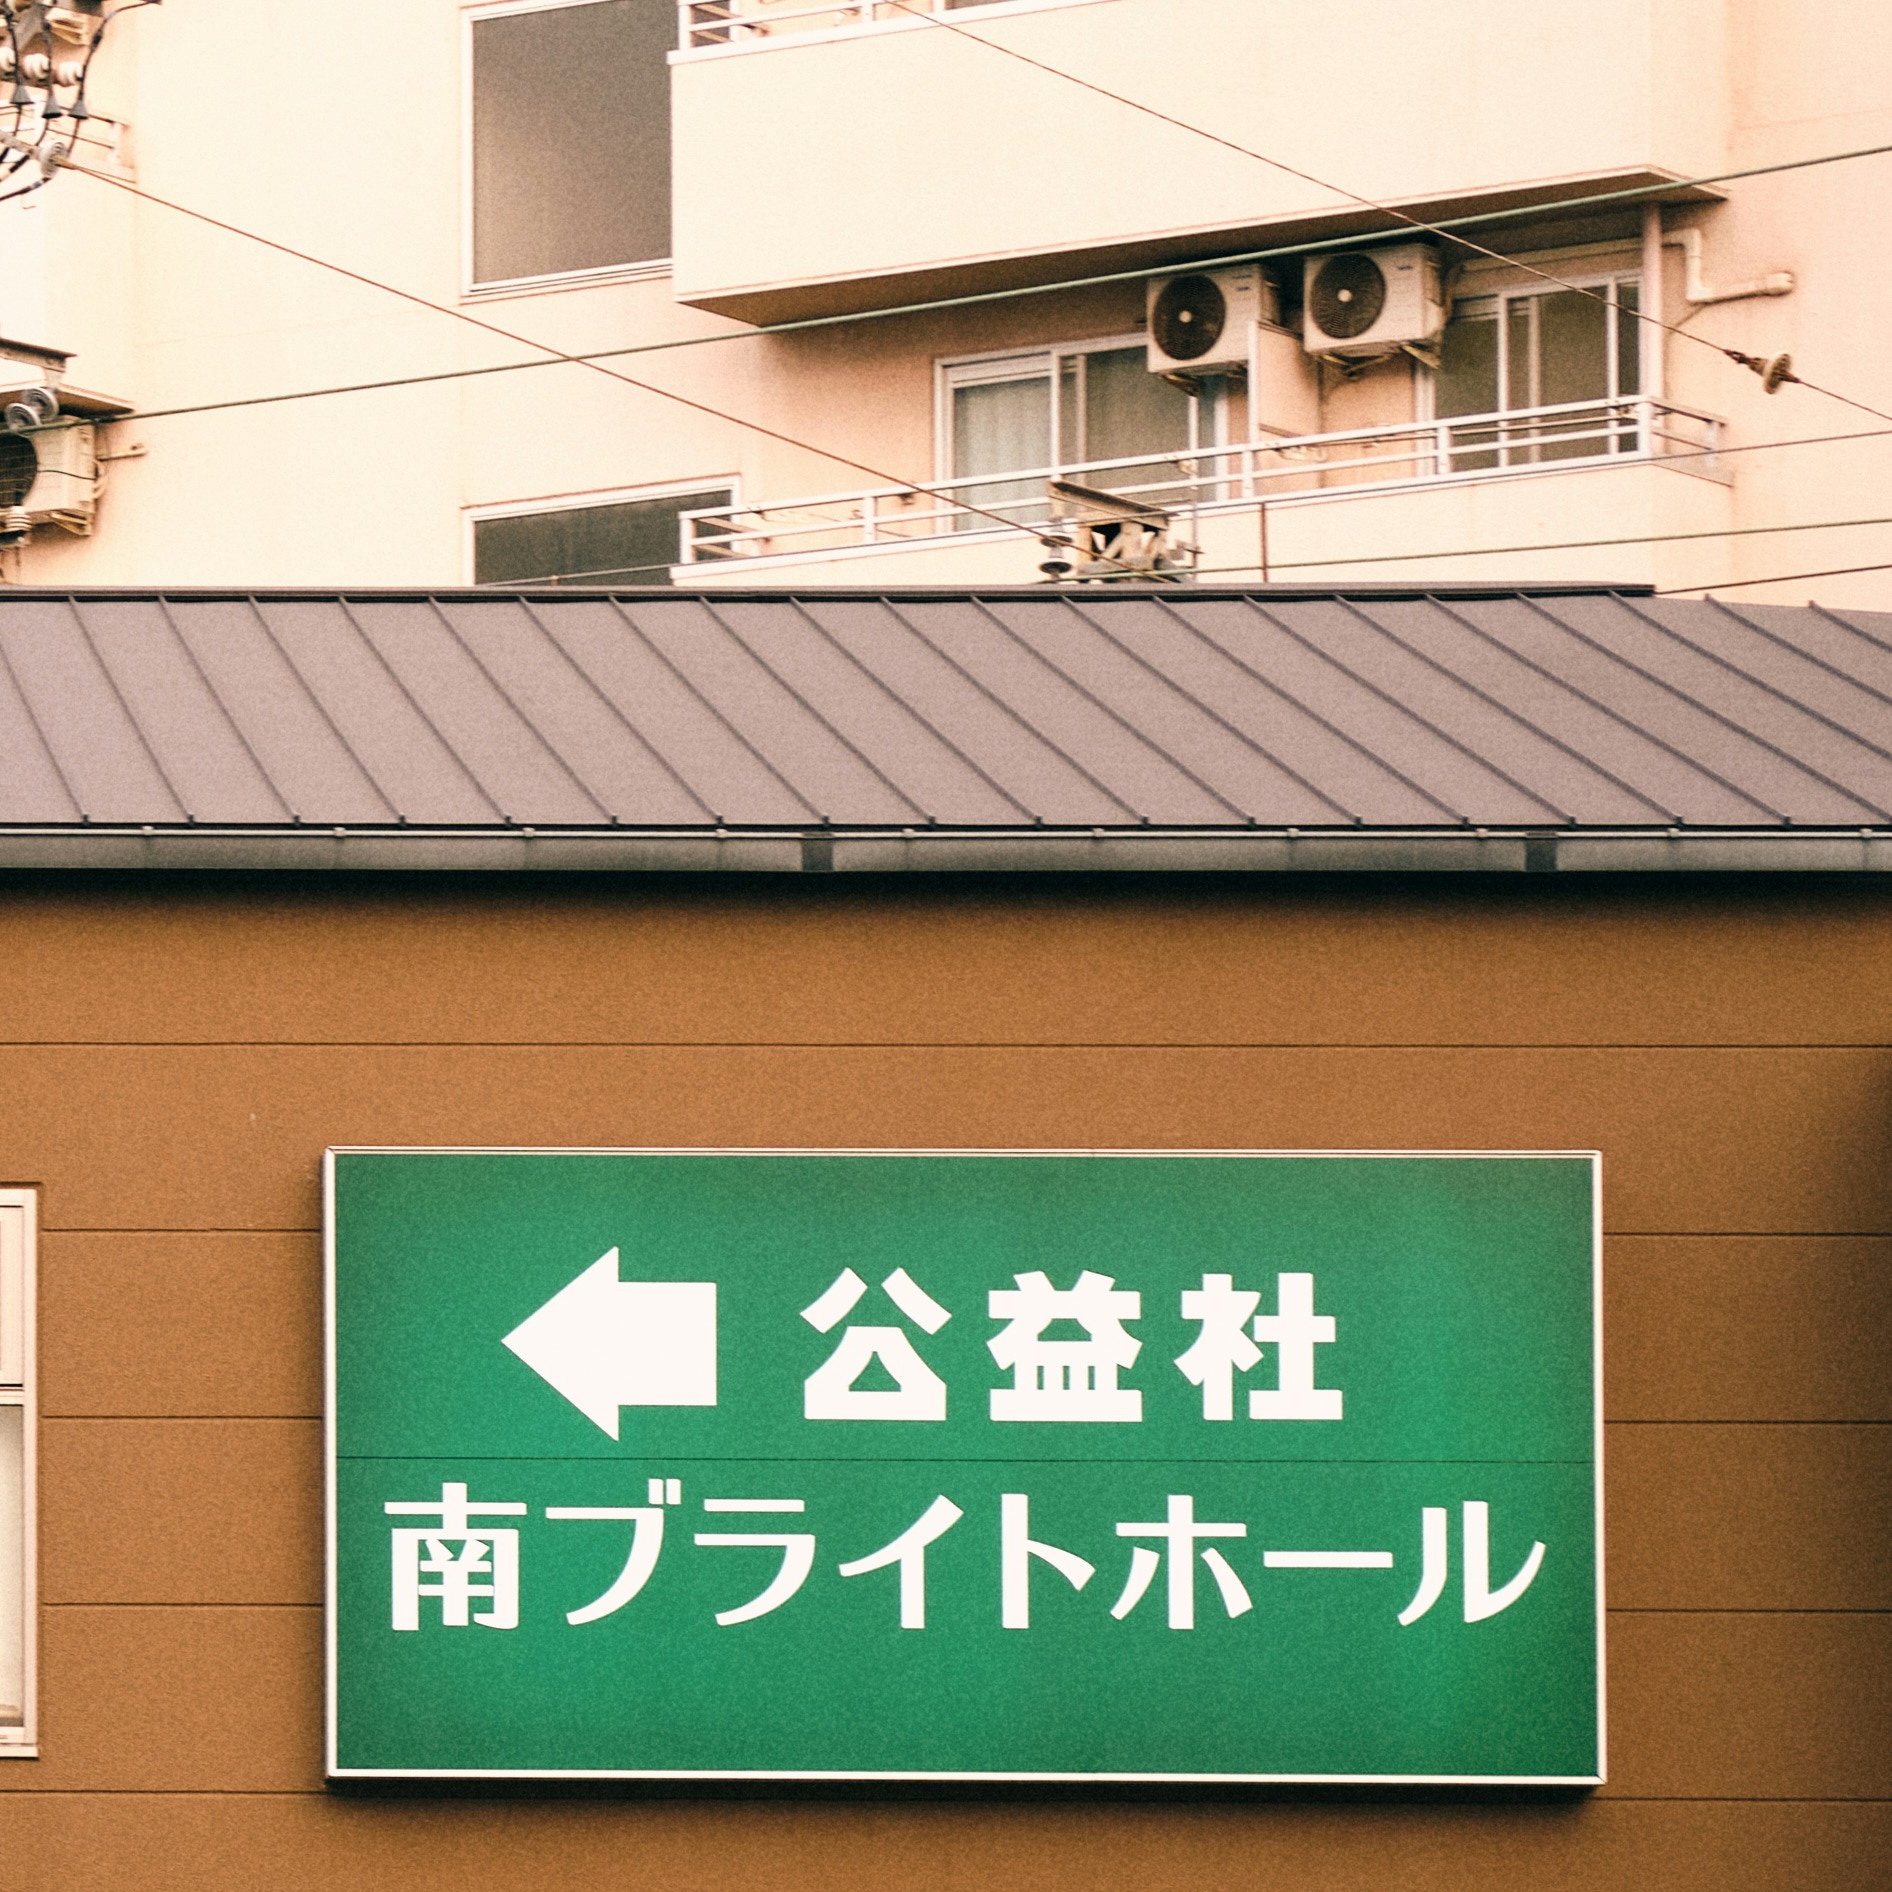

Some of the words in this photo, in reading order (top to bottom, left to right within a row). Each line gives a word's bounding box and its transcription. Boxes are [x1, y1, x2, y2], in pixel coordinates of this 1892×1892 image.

[799, 1266, 1343, 1422] 公益社
[384, 1478, 1547, 1631] 南ブライトホール
